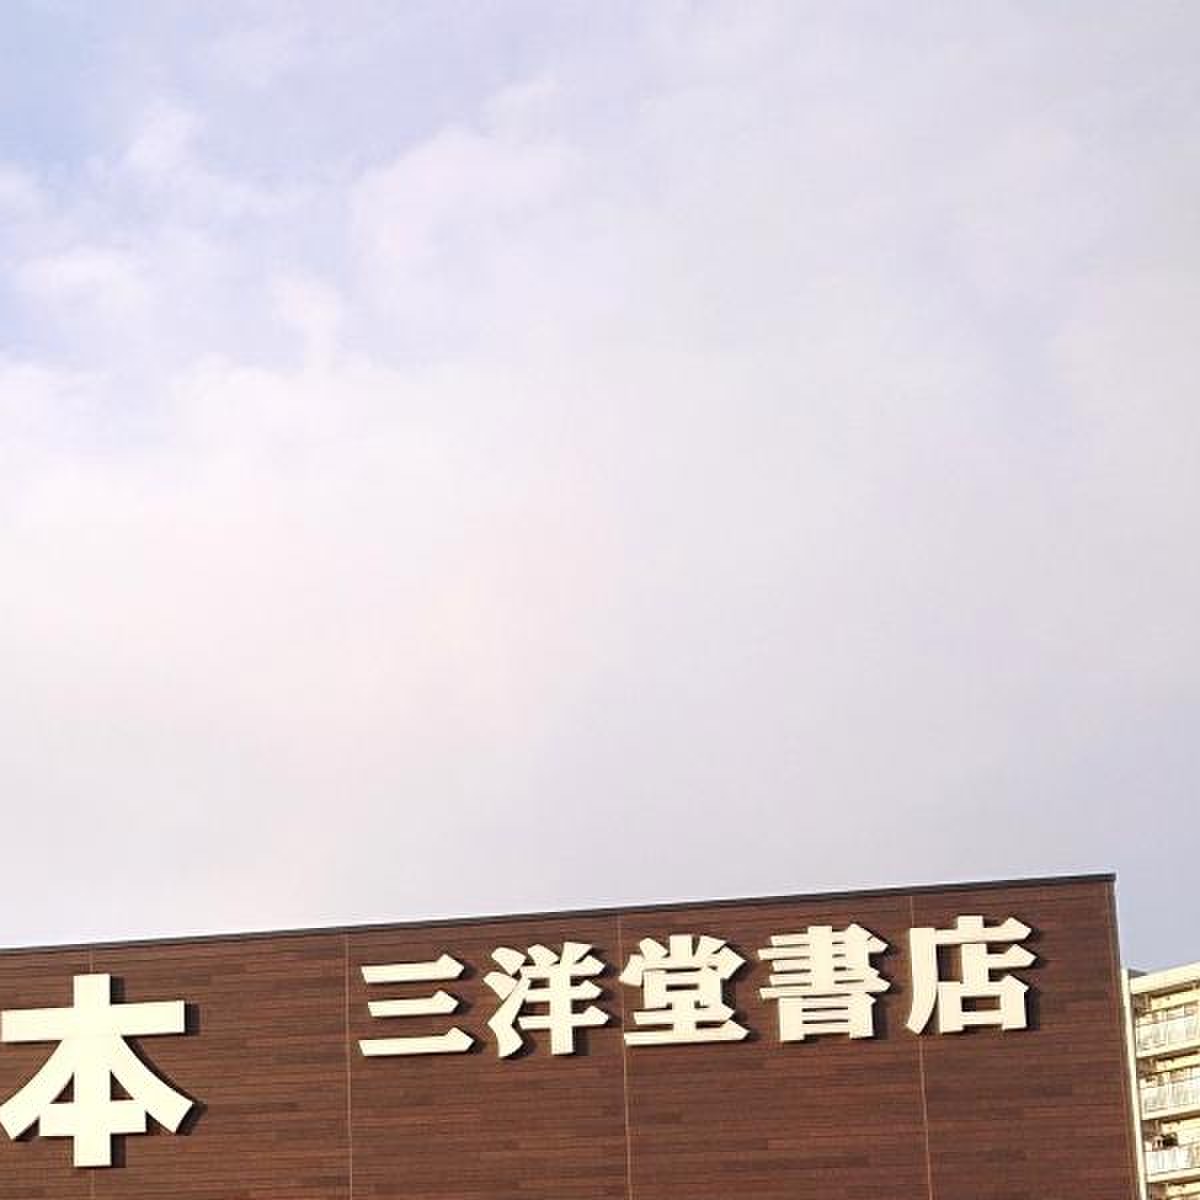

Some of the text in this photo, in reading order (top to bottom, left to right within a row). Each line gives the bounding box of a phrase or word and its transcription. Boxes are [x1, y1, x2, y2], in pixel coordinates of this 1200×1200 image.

[359, 915, 1036, 1057] 三洋堂書店
